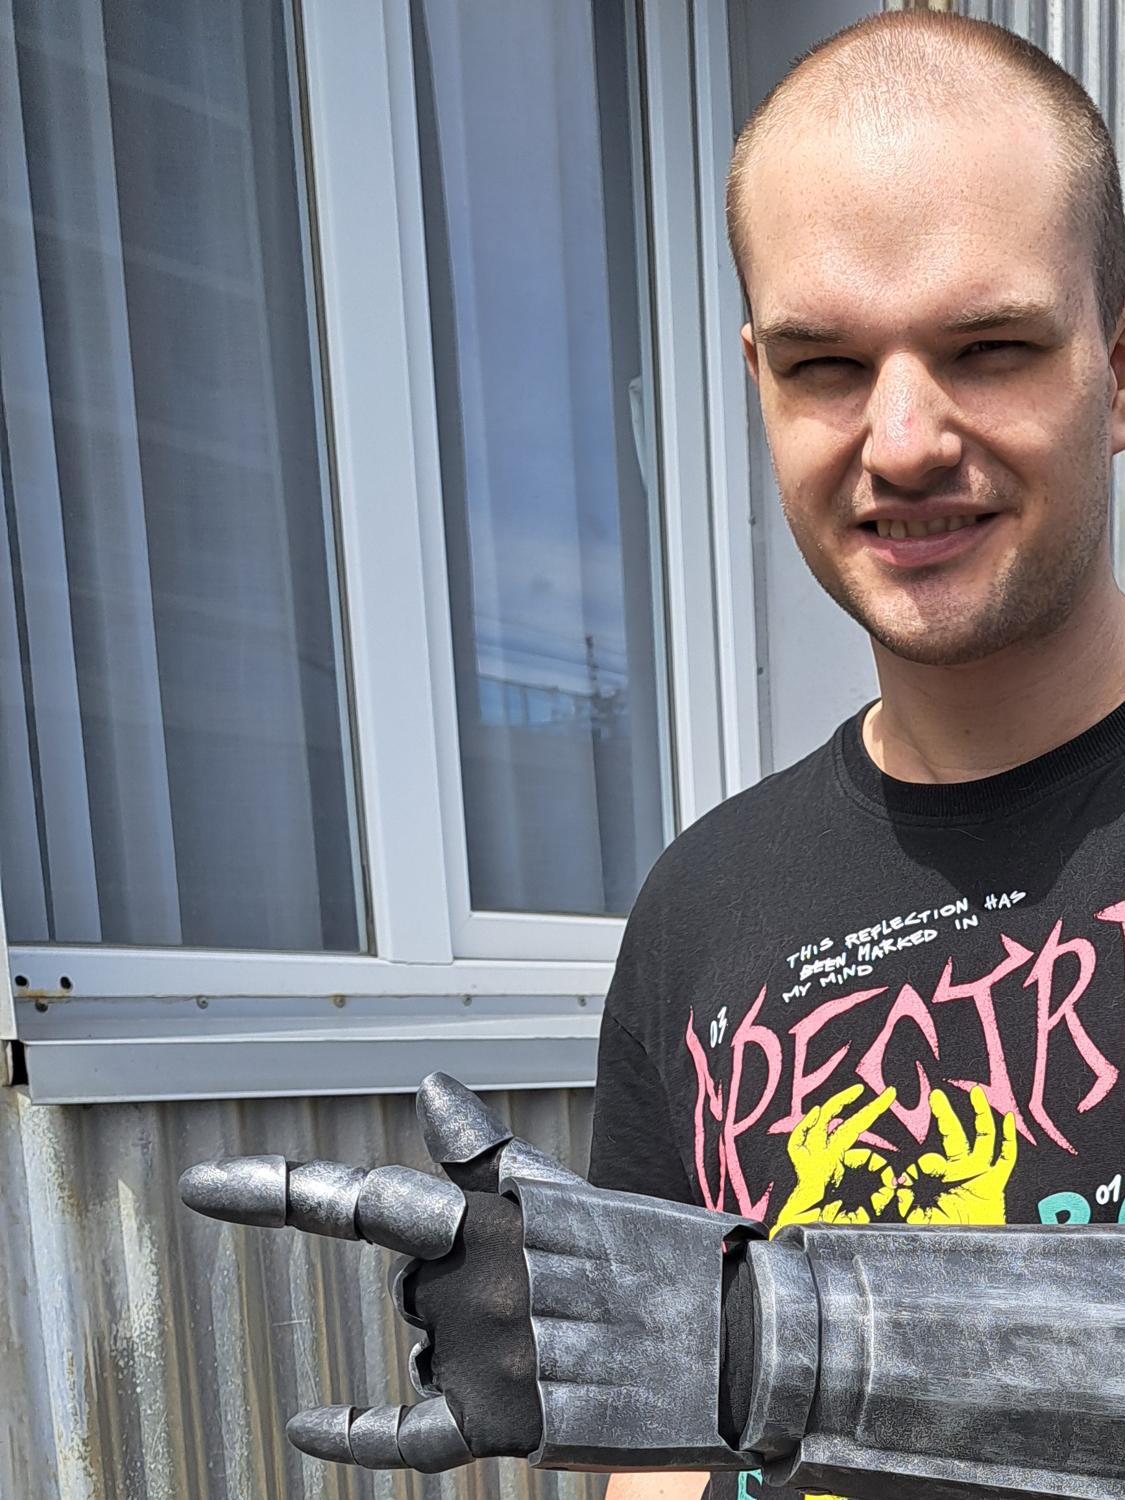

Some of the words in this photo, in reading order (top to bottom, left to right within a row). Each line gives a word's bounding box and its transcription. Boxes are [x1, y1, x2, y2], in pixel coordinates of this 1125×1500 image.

[787, 938, 834, 969] THIS
[845, 897, 969, 949] REFLECTION
[984, 890, 1027, 911] HAS
[800, 953, 847, 981] BEEN
[858, 929, 938, 962] MARKED
[954, 915, 979, 930] IN
[782, 983, 811, 1003] MY
[820, 964, 873, 988] MIND
[1095, 1173, 1122, 1205] 01
